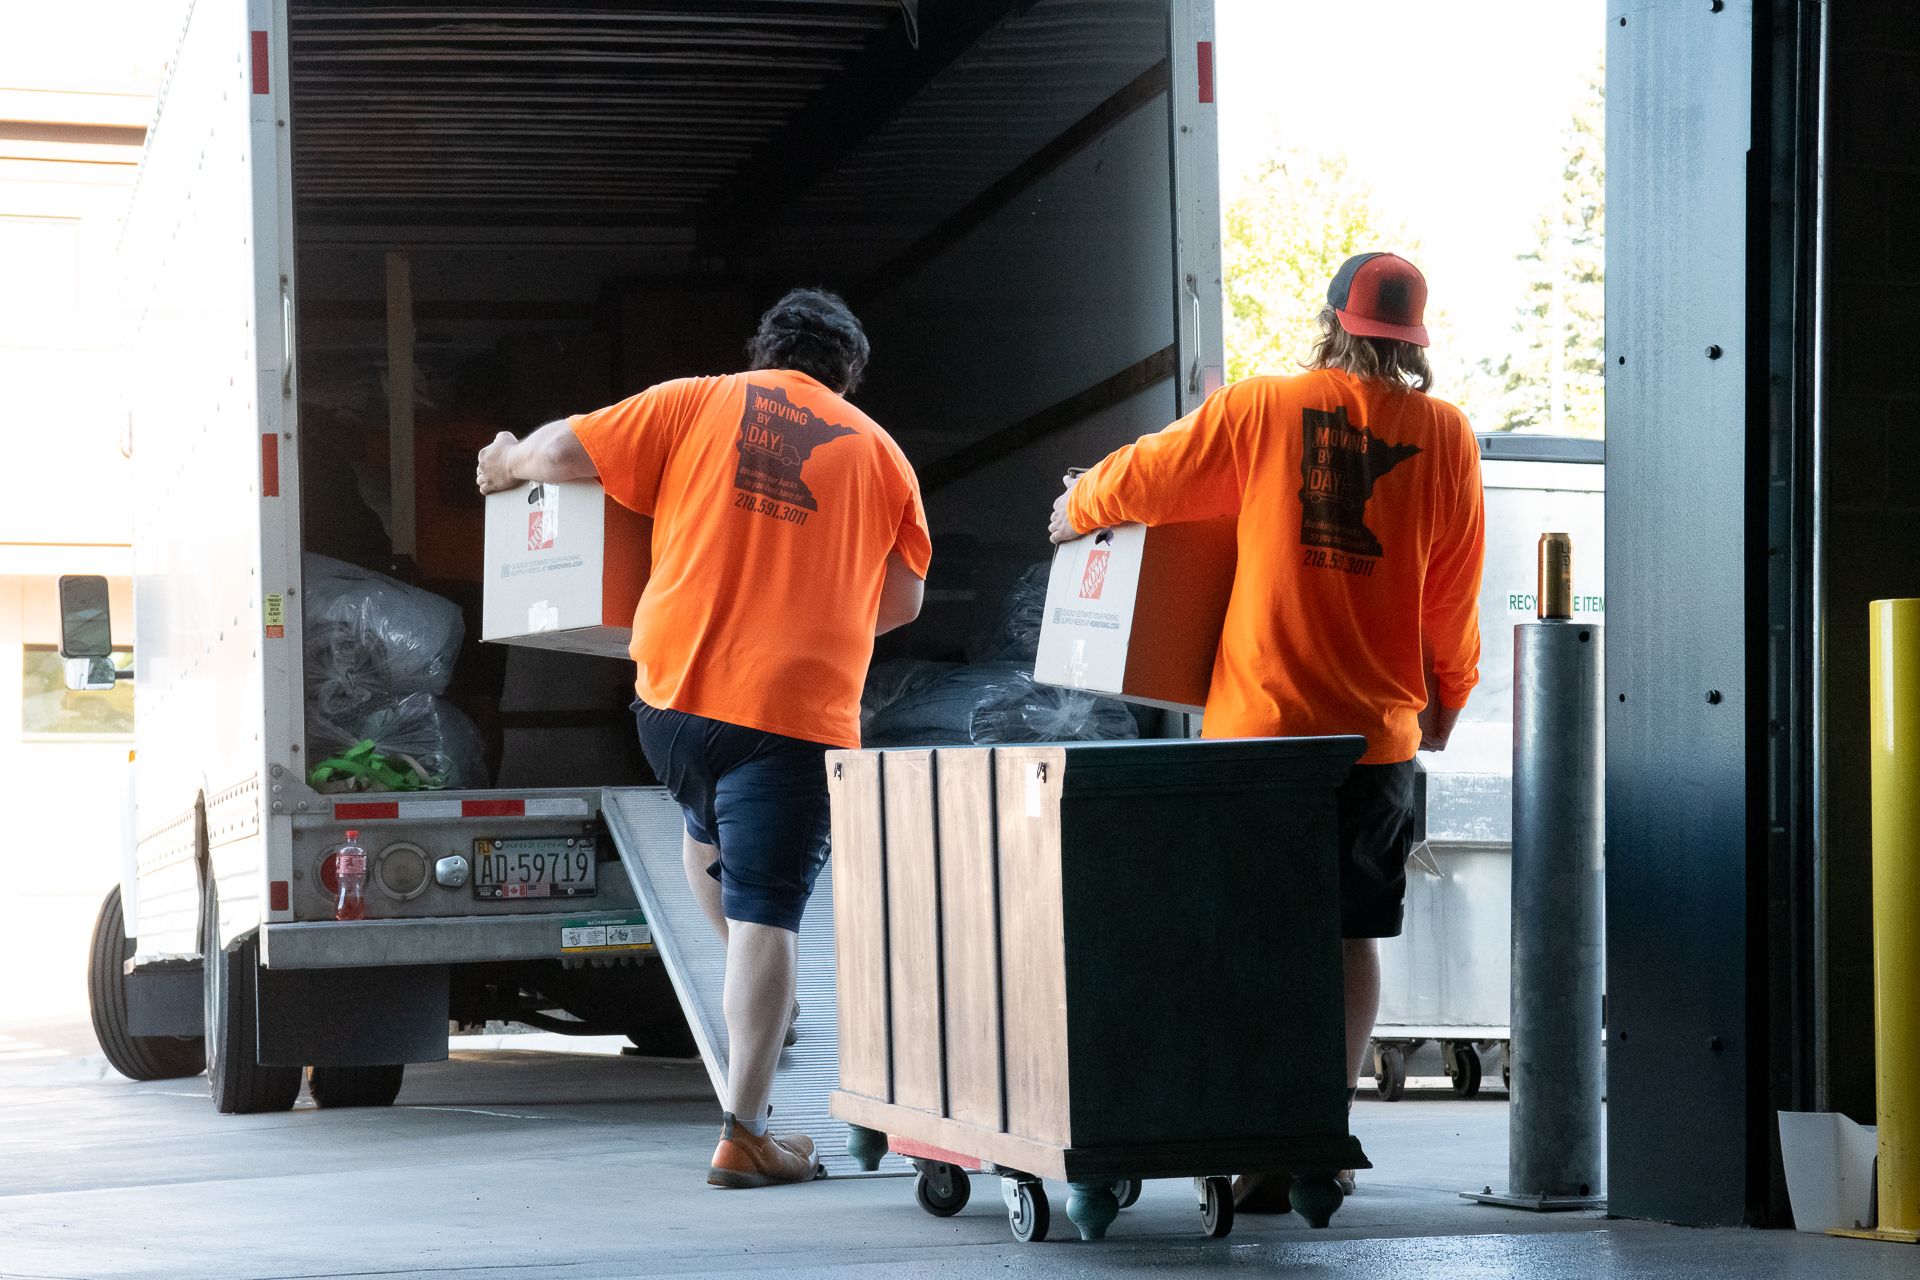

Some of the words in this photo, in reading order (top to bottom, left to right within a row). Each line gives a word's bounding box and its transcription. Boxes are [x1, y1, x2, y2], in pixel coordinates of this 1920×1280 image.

[756, 396, 808, 425] MOVING
[757, 413, 771, 426] BY
[748, 426, 781, 450] DAY
[1316, 426, 1368, 454] MOVING
[1318, 448, 1333, 464] BY
[752, 482, 764, 490] you
[1311, 468, 1342, 494] DAY
[734, 493, 808, 526] 218.591.3011
[504, 841, 568, 849] ARIZONA
